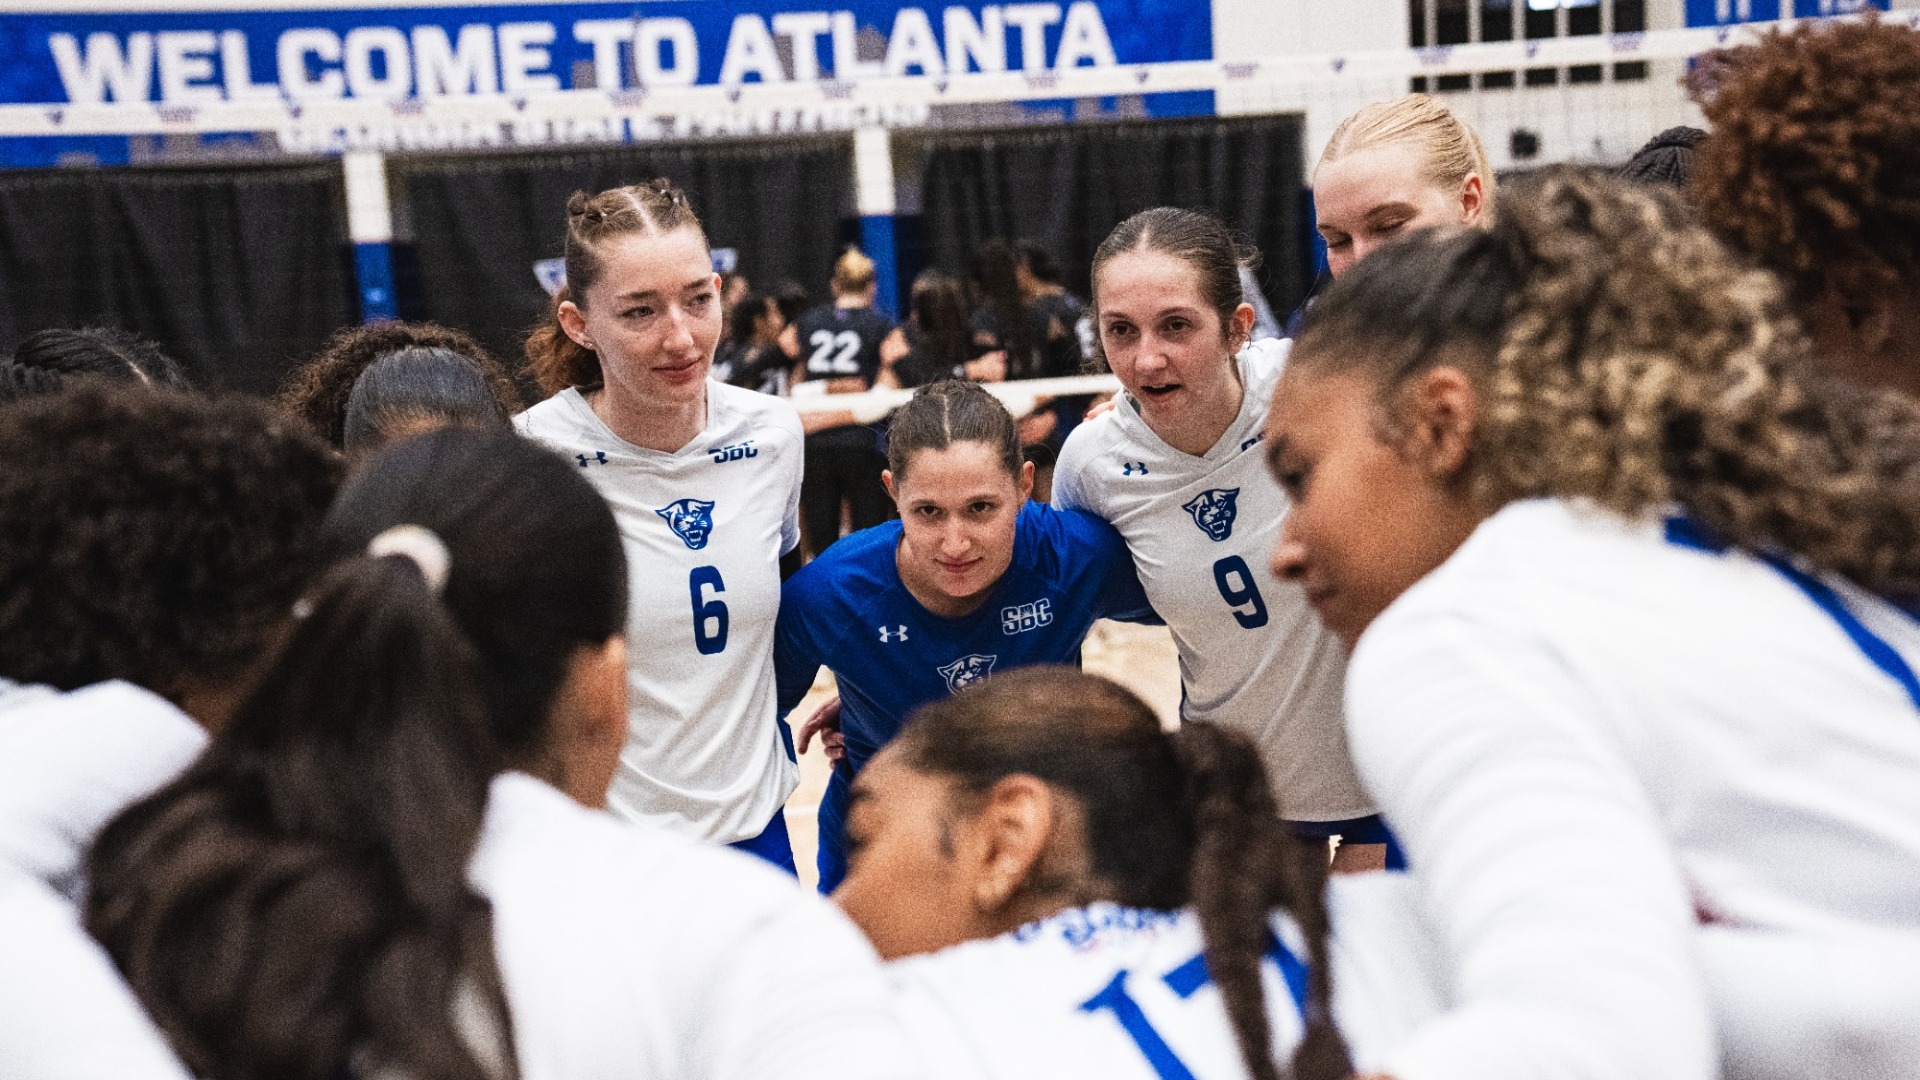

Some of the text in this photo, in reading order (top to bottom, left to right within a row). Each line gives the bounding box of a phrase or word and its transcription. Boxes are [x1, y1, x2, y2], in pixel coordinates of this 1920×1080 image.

[48, 2, 1118, 103] WELCOME TO ATLANTA
[807, 330, 862, 373] 22
[690, 565, 729, 655] 6
[1001, 598, 1053, 635] SBC
[1213, 555, 1268, 629] 9
